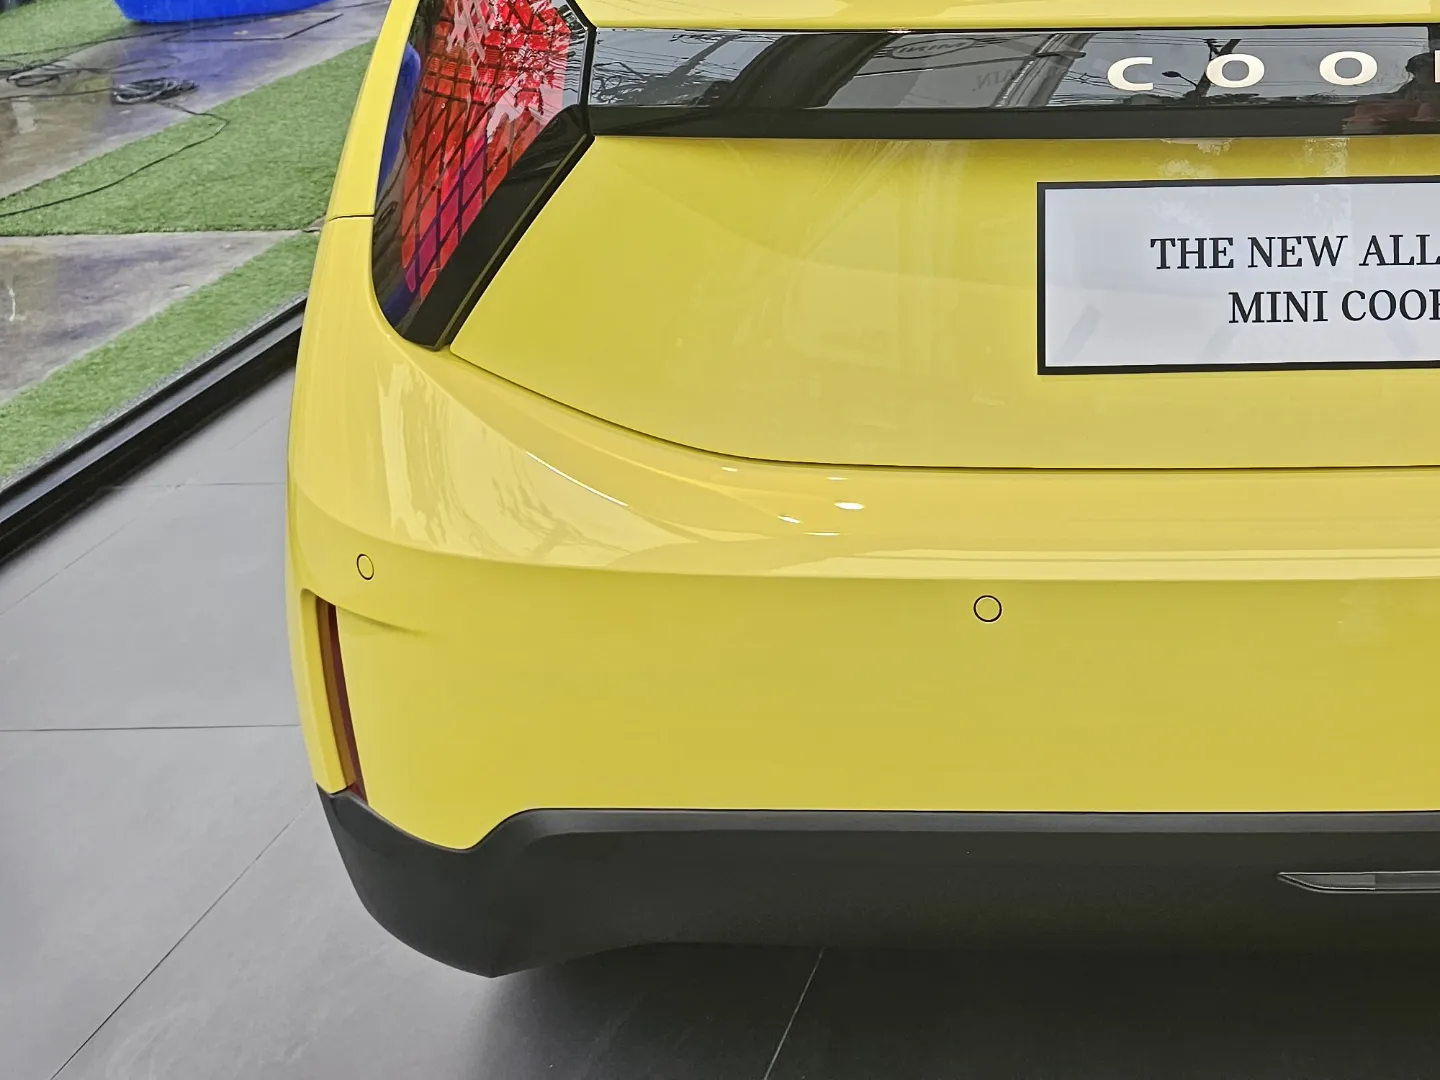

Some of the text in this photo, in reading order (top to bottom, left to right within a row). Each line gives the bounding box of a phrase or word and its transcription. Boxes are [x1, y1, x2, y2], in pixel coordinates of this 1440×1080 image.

[1150, 237, 1234, 270] THE
[1247, 235, 1348, 268] NEW
[1228, 290, 1328, 323] MINI
